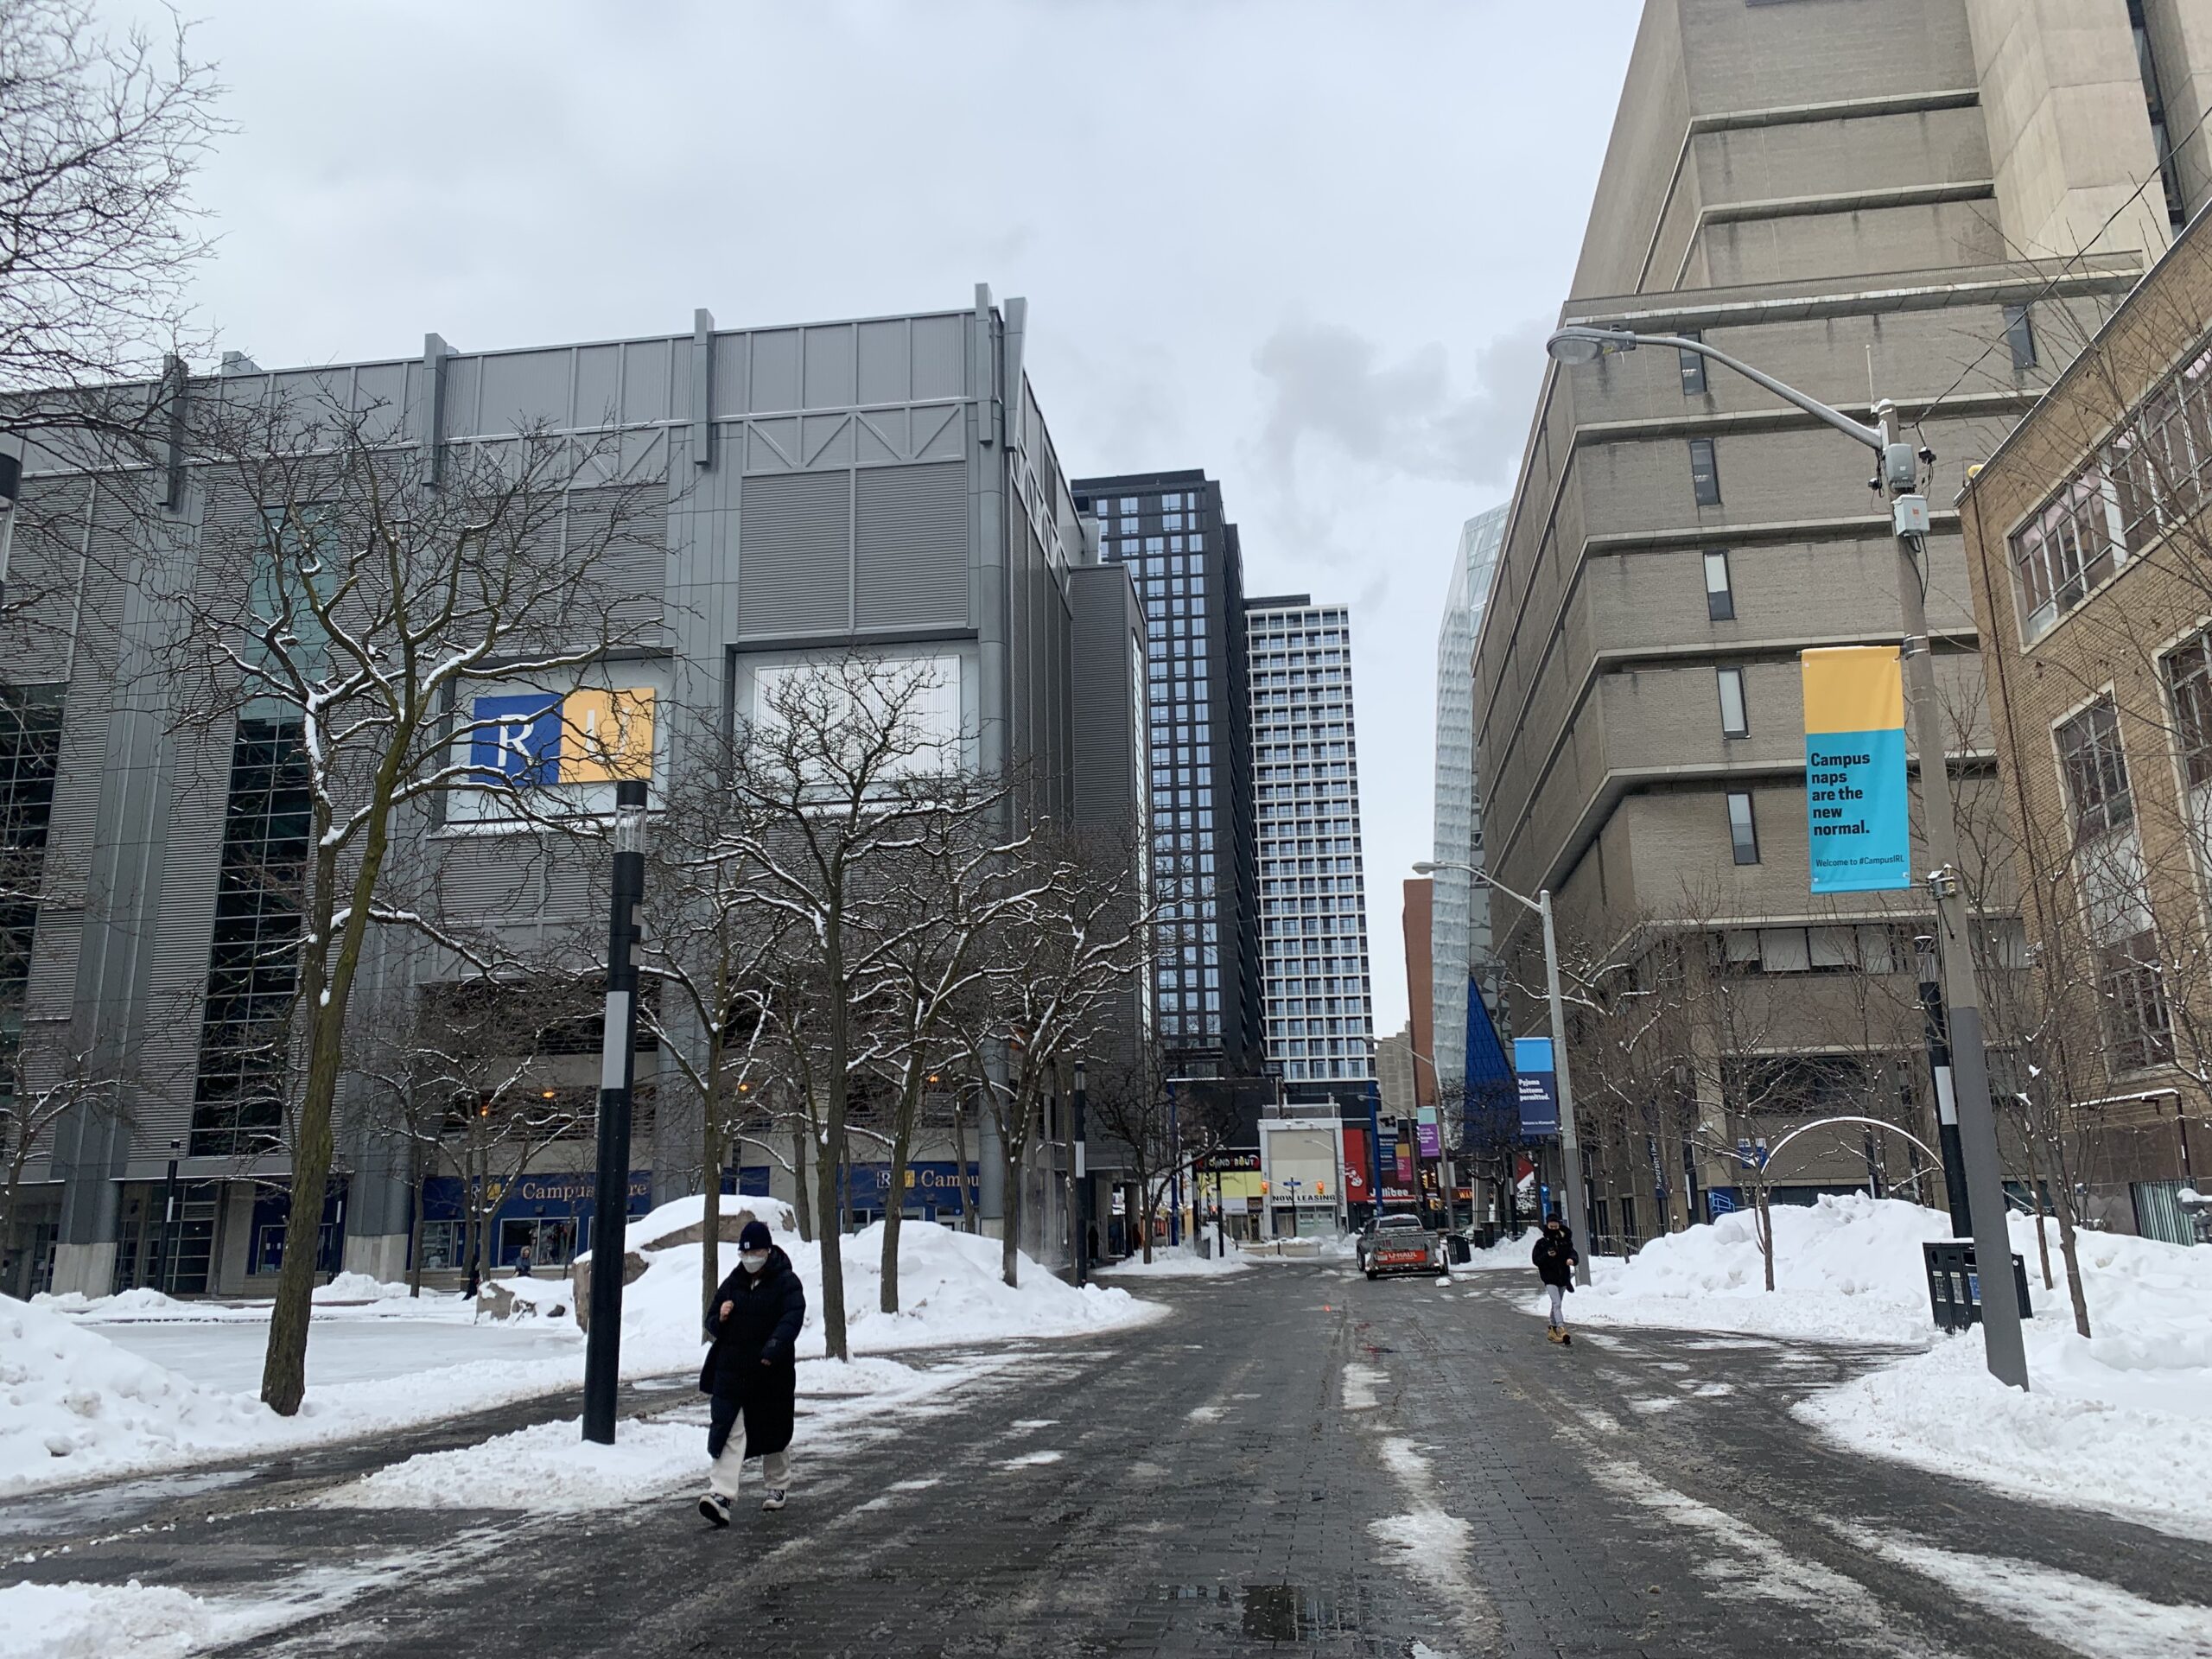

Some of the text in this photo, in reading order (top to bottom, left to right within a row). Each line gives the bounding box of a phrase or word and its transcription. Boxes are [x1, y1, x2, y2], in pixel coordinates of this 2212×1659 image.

[1811, 753, 1870, 768] Campus
[1812, 772, 1847, 786] naps
[1812, 786, 1864, 802] are the
[1813, 807, 1842, 819] new
[1814, 820, 1870, 836] normal.
[1815, 855, 1904, 868] Welcome to #CampusIRL
[1370, 1186, 1408, 1197] Jllibee
